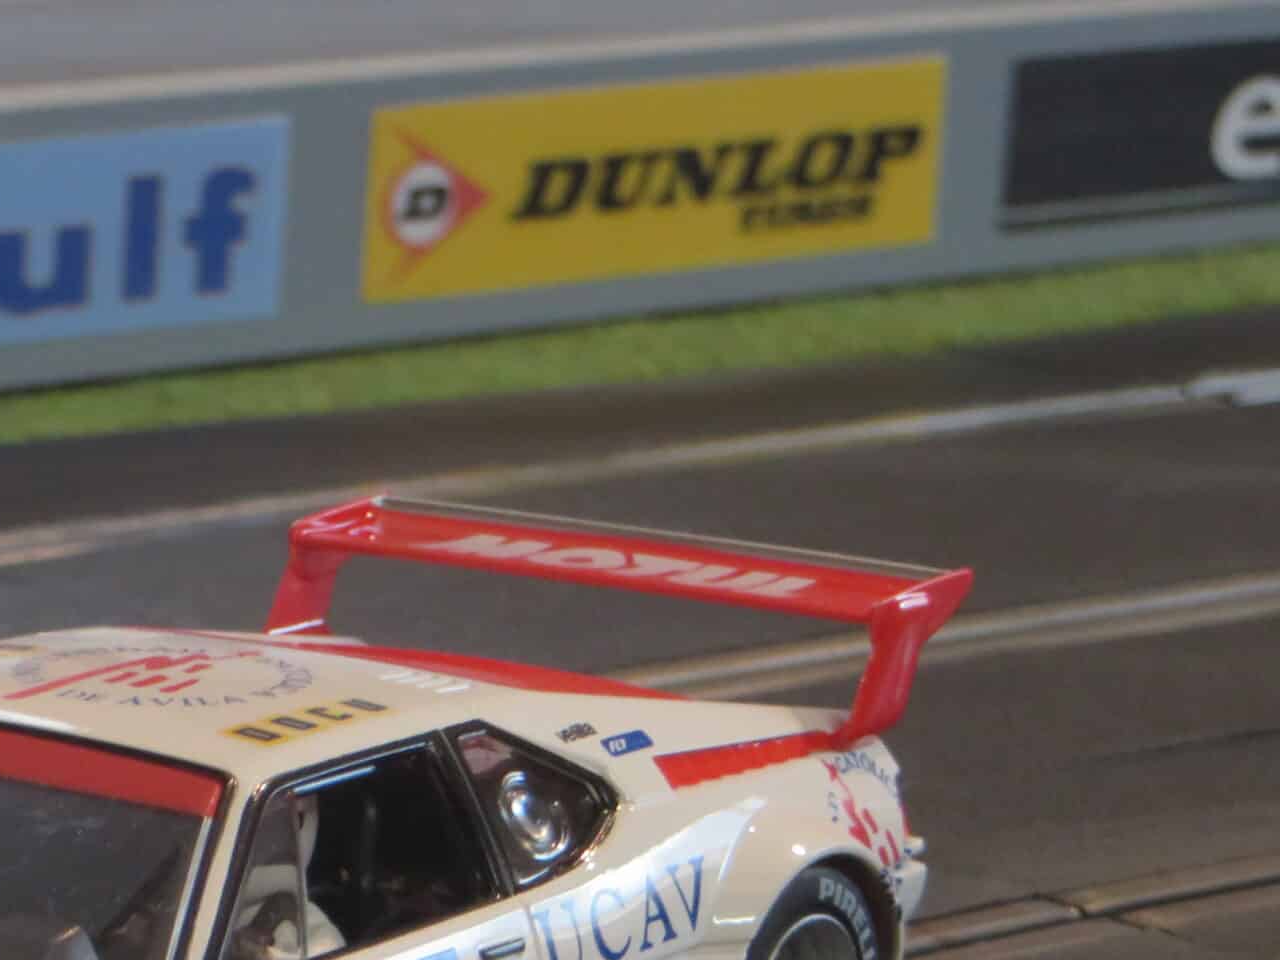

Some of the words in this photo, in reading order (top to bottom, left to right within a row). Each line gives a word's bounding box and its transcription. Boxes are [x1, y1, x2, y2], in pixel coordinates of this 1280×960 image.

[401, 186, 449, 222] D
[510, 126, 923, 223] DUNLOP
[411, 533, 817, 597] MOTUL
